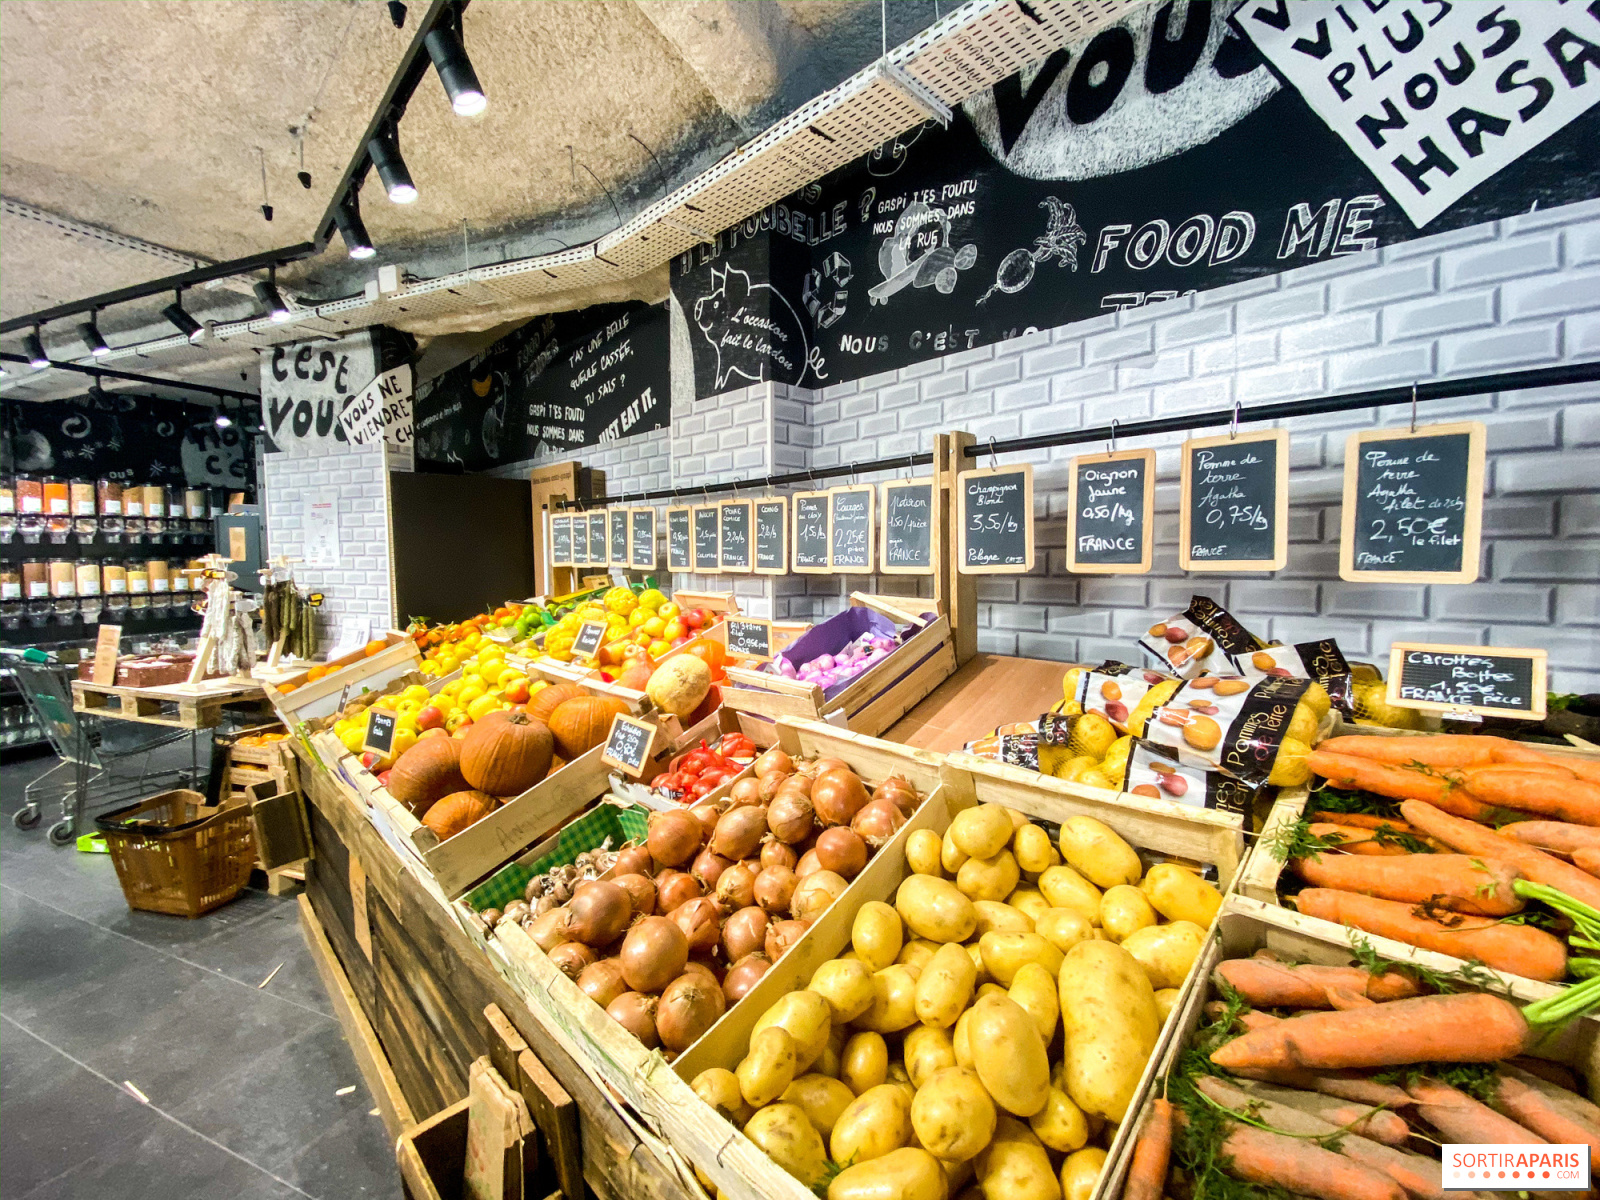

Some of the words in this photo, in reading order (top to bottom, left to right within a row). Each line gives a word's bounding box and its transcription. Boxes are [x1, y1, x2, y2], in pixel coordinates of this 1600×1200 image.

[1356, 5, 1521, 150] NOUS
[942, 179, 978, 201] FOUTU
[873, 220, 894, 235] NOUS
[900, 210, 940, 231] SOMMES
[947, 201, 976, 219] DANS
[899, 235, 911, 251] LA
[1091, 210, 1256, 273] FOOD
[1276, 194, 1386, 260] ME
[606, 312, 630, 341] BELLE
[720, 329, 742, 347] fait
[839, 334, 888, 354] NOUS
[585, 392, 595, 406] TU
[598, 378, 616, 401] SAIS
[620, 373, 626, 387] ?
[344, 392, 375, 430] VOUS
[377, 375, 402, 399] NE
[564, 406, 585, 422] FOUTU
[620, 399, 641, 432] EAT
[526, 423, 540, 437] NOUS
[542, 425, 565, 440] SOMMES
[568, 428, 585, 443] DANS
[1197, 450, 1236, 470] Pomme
[1240, 453, 1263, 464] de
[1415, 450, 1440, 463] de
[1085, 469, 1138, 486] Oignon
[1199, 470, 1247, 484] terre
[1383, 496, 1426, 514] filet
[1206, 504, 1268, 530] 0,75/kg
[834, 528, 866, 548] 2,25€
[1079, 535, 1135, 553] FRANCE
[1412, 535, 1425, 546] le
[1428, 534, 1461, 546] filet
[723, 553, 744, 561] FRANCE
[834, 554, 864, 565] FRANCE
[889, 546, 921, 561] FRANCE
[1408, 652, 1495, 669] Carottes
[1452, 667, 1515, 683] Bottes
[1401, 686, 1475, 706] FRANCE
[1226, 712, 1270, 767] Pommes
